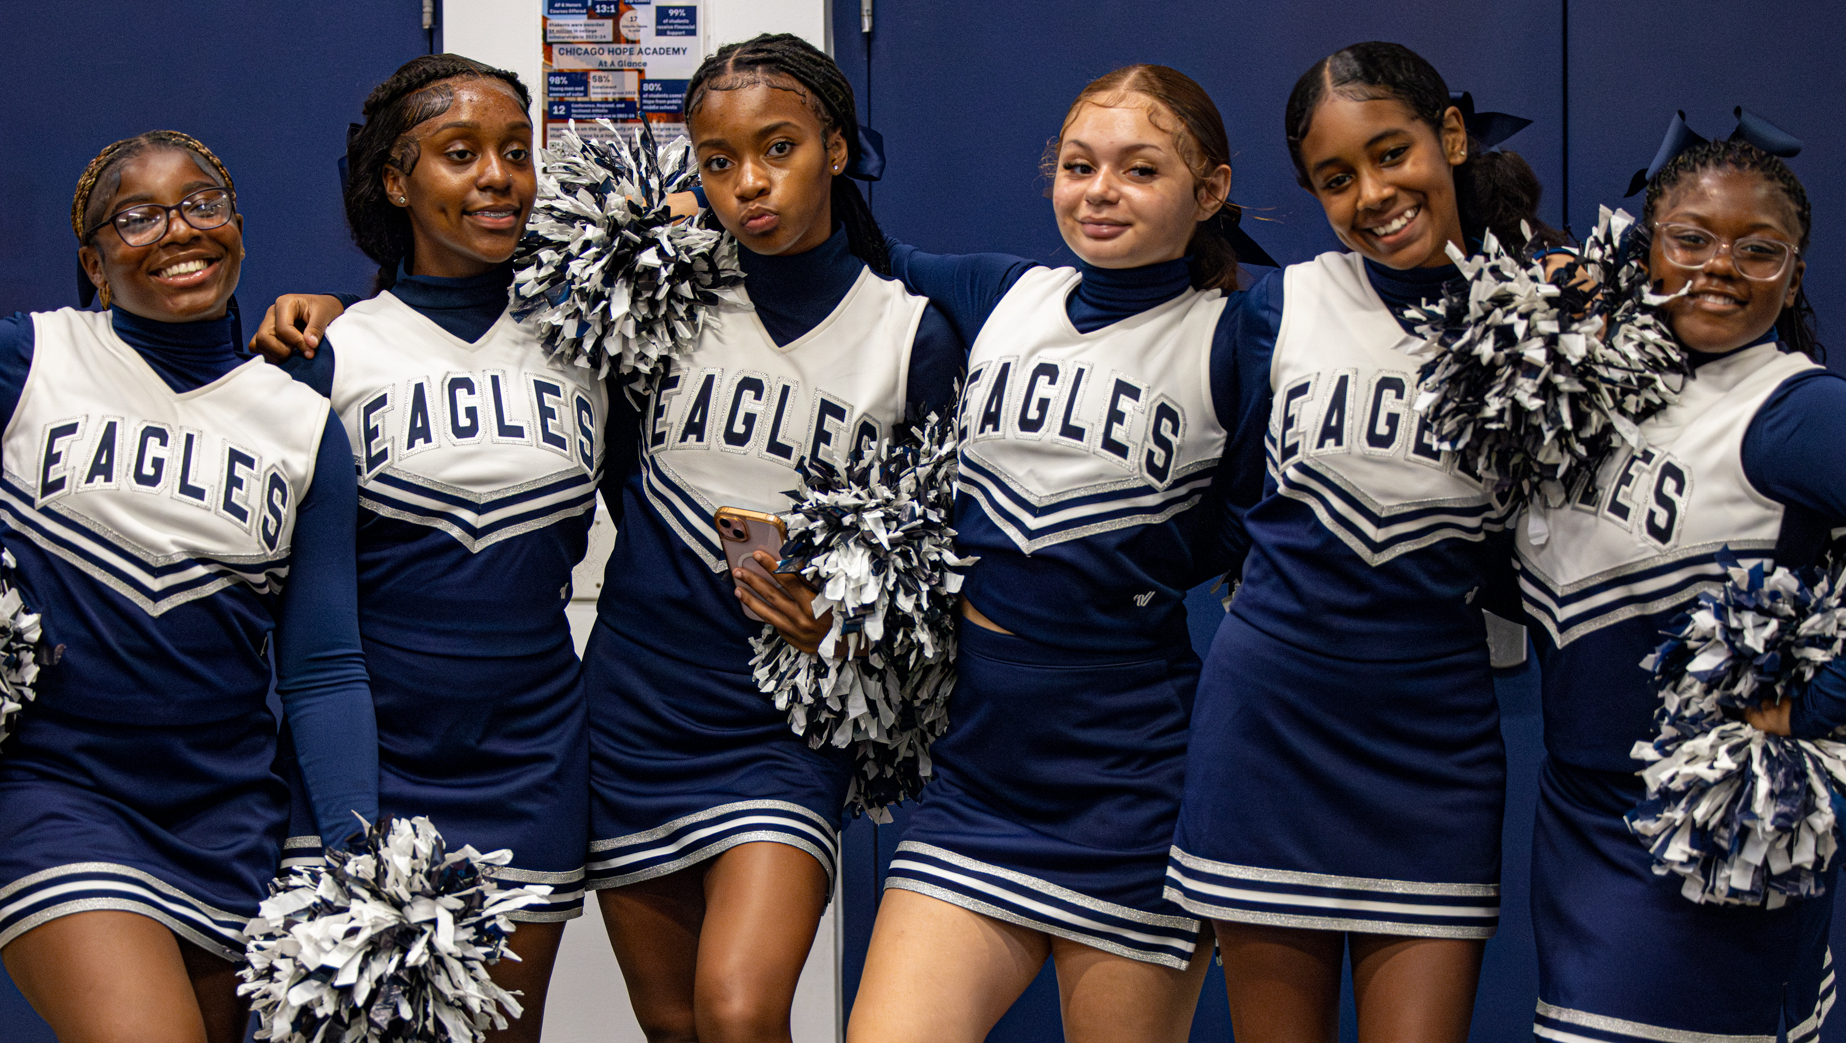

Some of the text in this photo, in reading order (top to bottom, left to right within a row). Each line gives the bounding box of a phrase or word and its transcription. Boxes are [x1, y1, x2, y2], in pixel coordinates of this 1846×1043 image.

[595, 4, 616, 13] 13:1
[558, 47, 687, 55] CHICAGO HOPE ACADEMY
[549, 76, 568, 84] 98%
[643, 83, 662, 91] 80%
[553, 105, 566, 115] 12
[360, 371, 595, 480] EAGLES
[957, 356, 1186, 490] EAGLES
[37, 417, 291, 554] EAGLES
